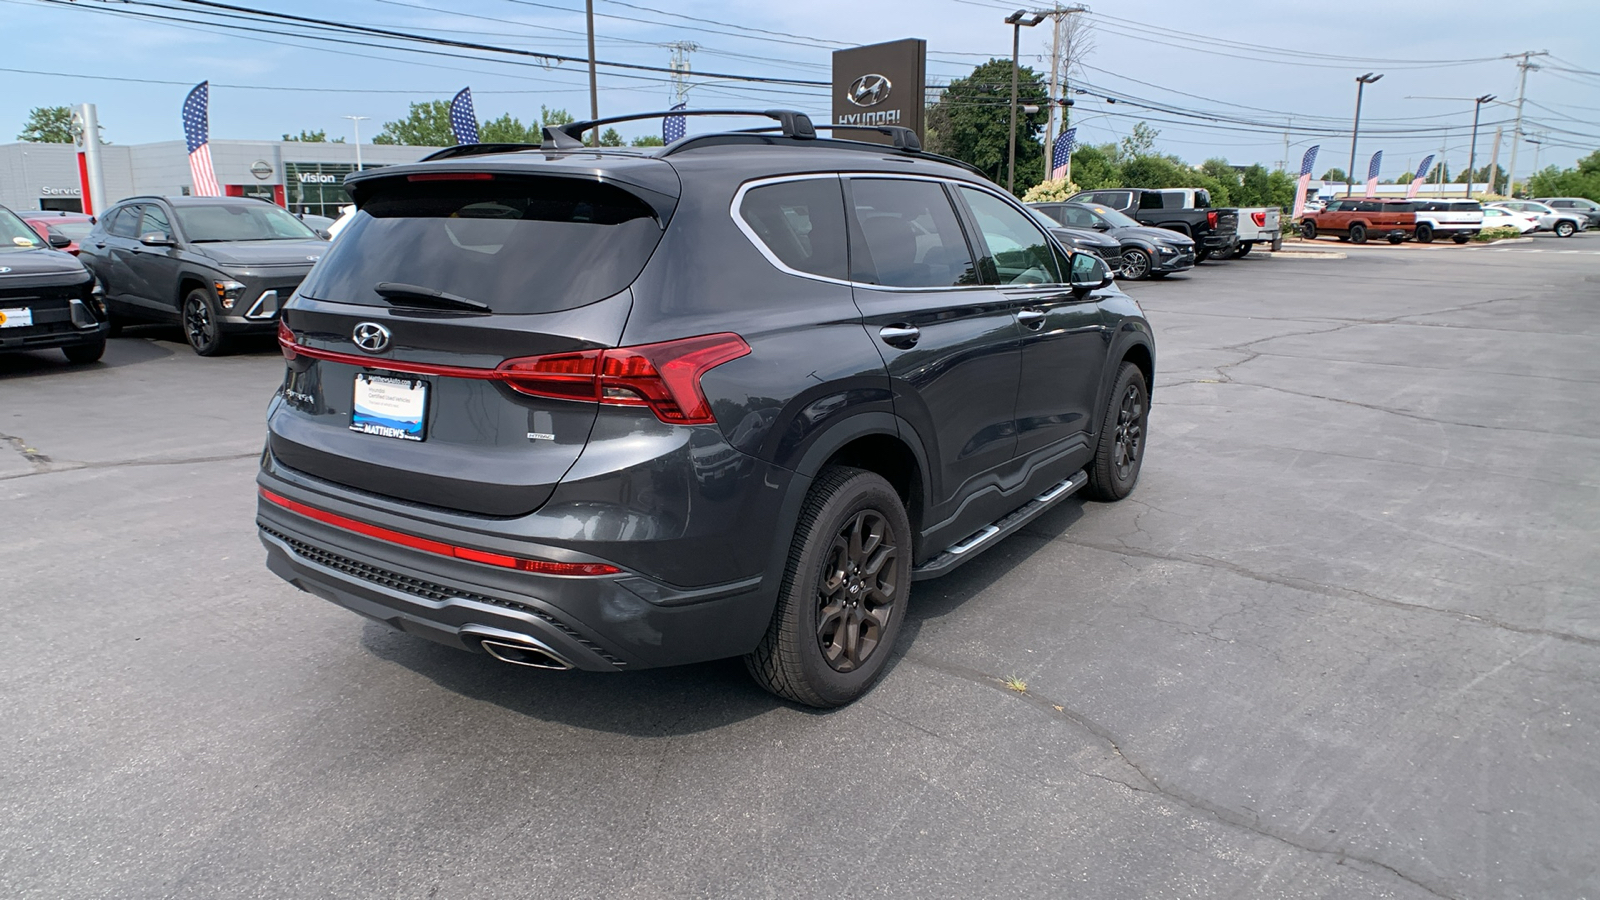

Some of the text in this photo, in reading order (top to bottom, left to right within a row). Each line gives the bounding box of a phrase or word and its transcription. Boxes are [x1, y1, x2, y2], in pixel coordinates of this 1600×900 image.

[838, 109, 901, 126] HYUNDAI
[298, 172, 336, 183] Vision
[42, 186, 81, 195] Servic
[364, 424, 405, 438] MATTHEWS
